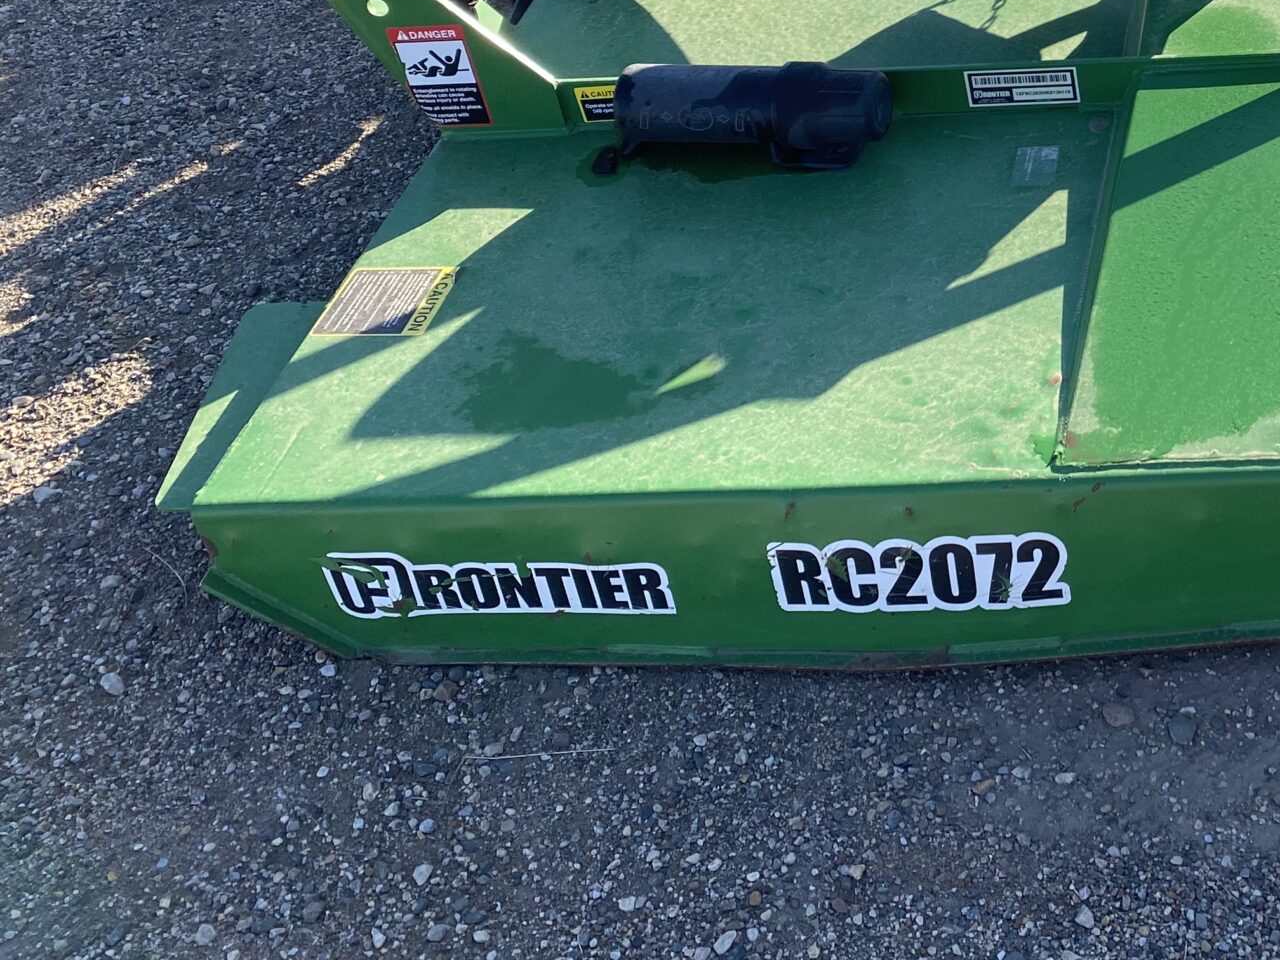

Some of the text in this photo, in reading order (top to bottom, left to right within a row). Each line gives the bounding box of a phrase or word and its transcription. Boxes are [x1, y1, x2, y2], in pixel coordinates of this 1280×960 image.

[408, 30, 456, 39] DANGER
[408, 282, 447, 331] CAUTION
[776, 541, 1062, 603] RC2072
